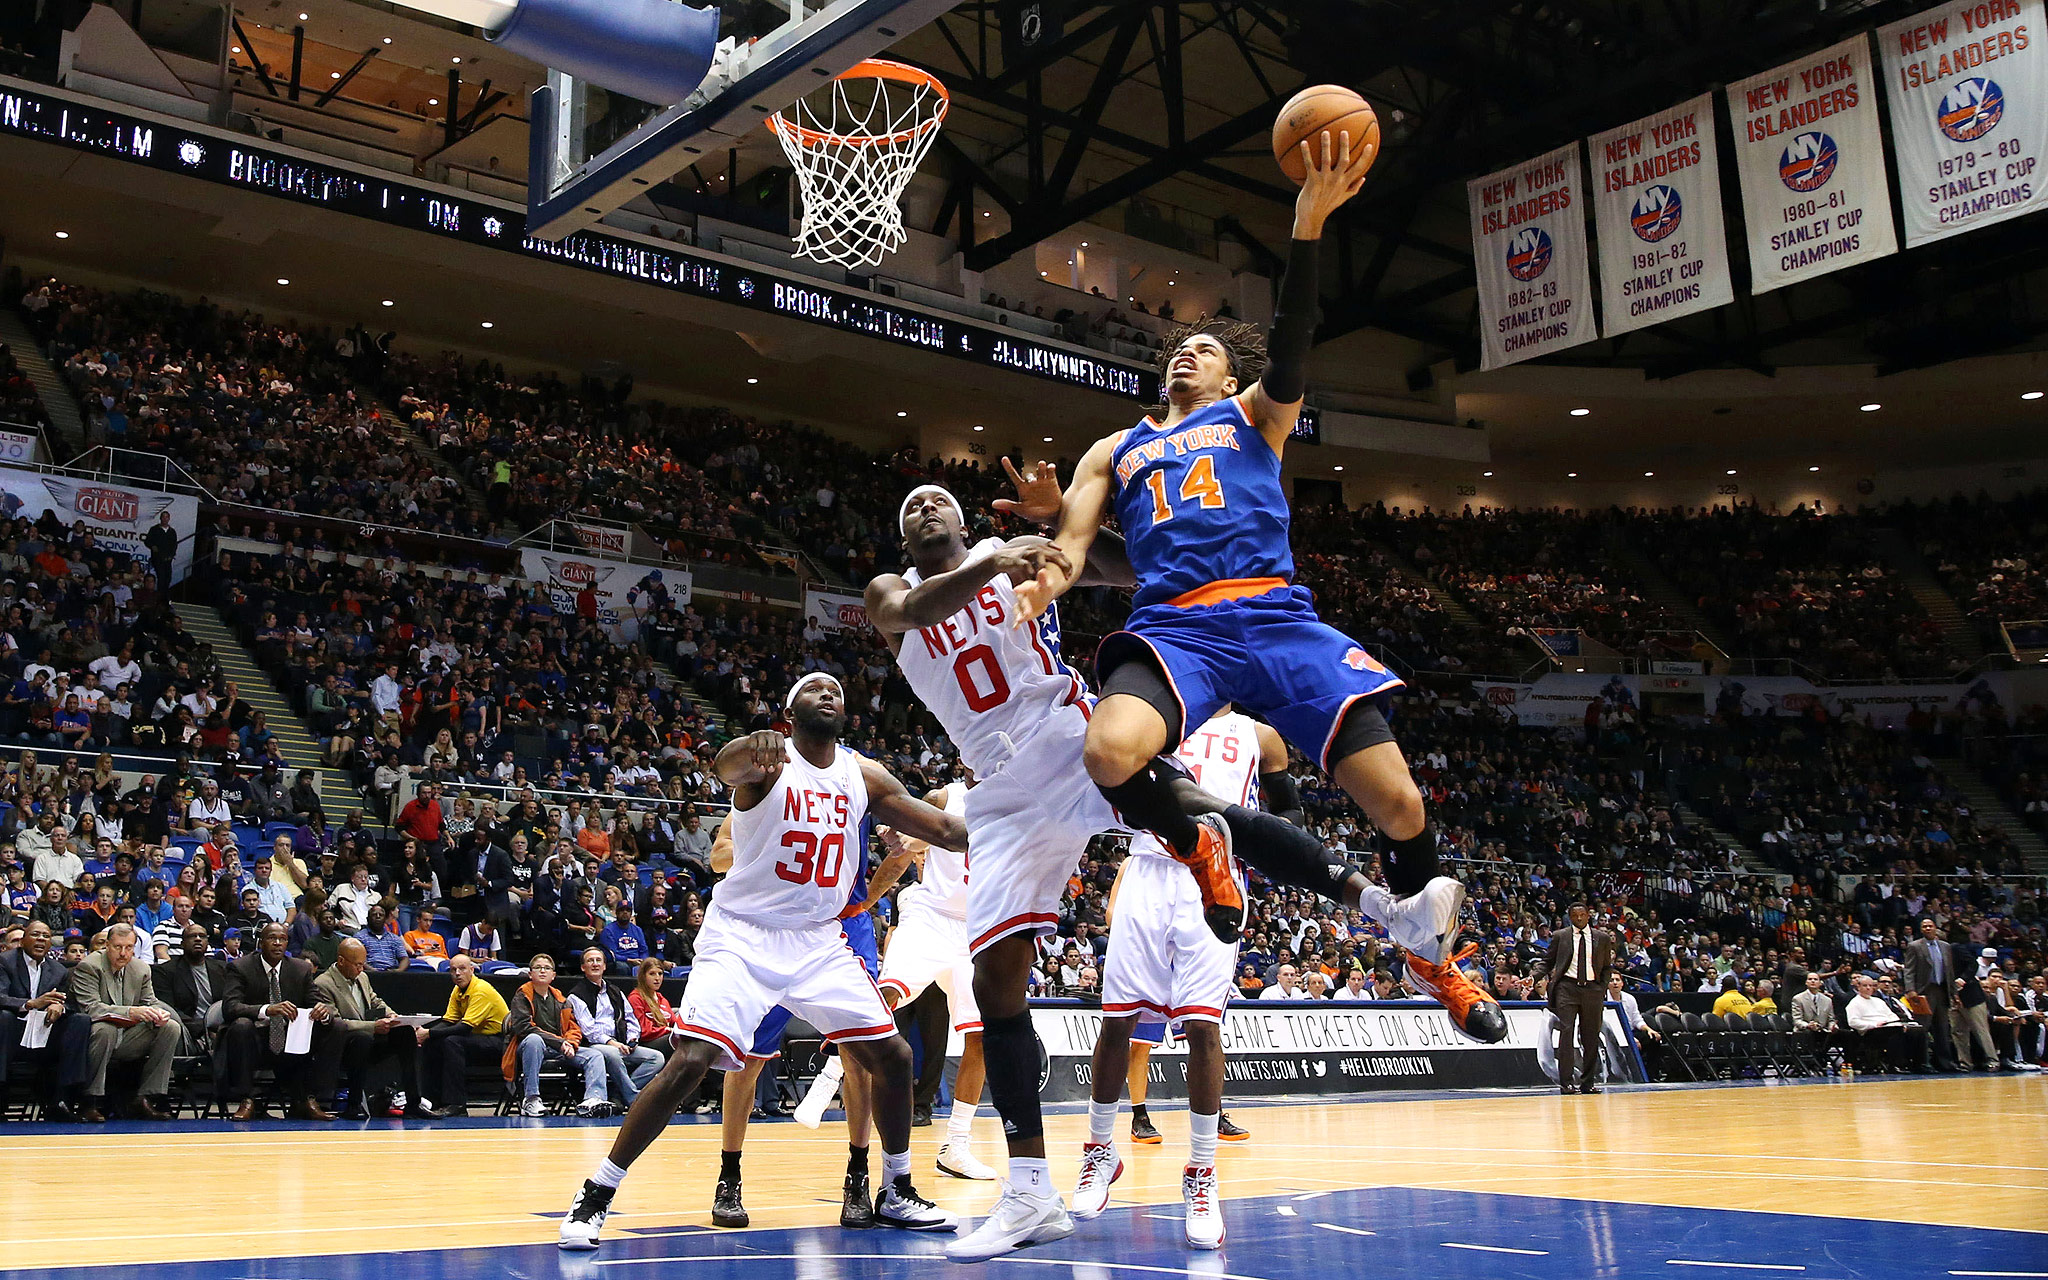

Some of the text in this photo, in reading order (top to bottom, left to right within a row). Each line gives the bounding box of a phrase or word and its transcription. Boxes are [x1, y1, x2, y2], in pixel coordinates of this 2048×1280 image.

[1900, 0, 2021, 57] NEW YORK
[1901, 25, 2029, 91] ISLANDERS
[1746, 54, 1853, 113] NEW YORK
[1747, 83, 1859, 142] ISLANDERS
[1605, 113, 1697, 164] NEW YORK
[1482, 160, 1565, 207] NEW YORK
[1605, 141, 1701, 192] ISLANDERS
[1929, 157, 2036, 203] STANLEY CUP
[1482, 187, 1571, 235] ISLANDERS
[1783, 189, 1845, 223] 1980-81
[1939, 183, 2032, 223] CHAMPIONS
[1771, 208, 1863, 251] STANLEY CUP
[1633, 242, 1687, 270] 1981-82
[1781, 234, 1860, 271] CHAMPIONS
[1508, 281, 1557, 308] 1982-83
[1623, 260, 1704, 296] STANLEY CUP
[1498, 299, 1571, 333] STANLEY CUP
[1631, 283, 1700, 317] CHAMPIONS
[1505, 322, 1568, 352] CHAMPIONS
[968, 442, 986, 455] 326
[1116, 438, 1166, 490] NEW
[1166, 424, 1241, 456] YORK
[79, 495, 136, 518] GIANT
[1145, 454, 1226, 525] 14
[359, 525, 376, 537] 217
[562, 567, 594, 581] GIANT
[673, 583, 687, 595] 218
[953, 643, 1011, 713] 0
[1179, 731, 1240, 764] ETS
[783, 786, 849, 828] NETS
[775, 830, 845, 888] 30
[1221, 1015, 1281, 1050] GAME
[1284, 1013, 1372, 1049] TICKETS
[1385, 1014, 1411, 1047] ON
[808, 1052, 816, 1072] 6
[1339, 1056, 1434, 1077] #HELLOBROOKLYN
